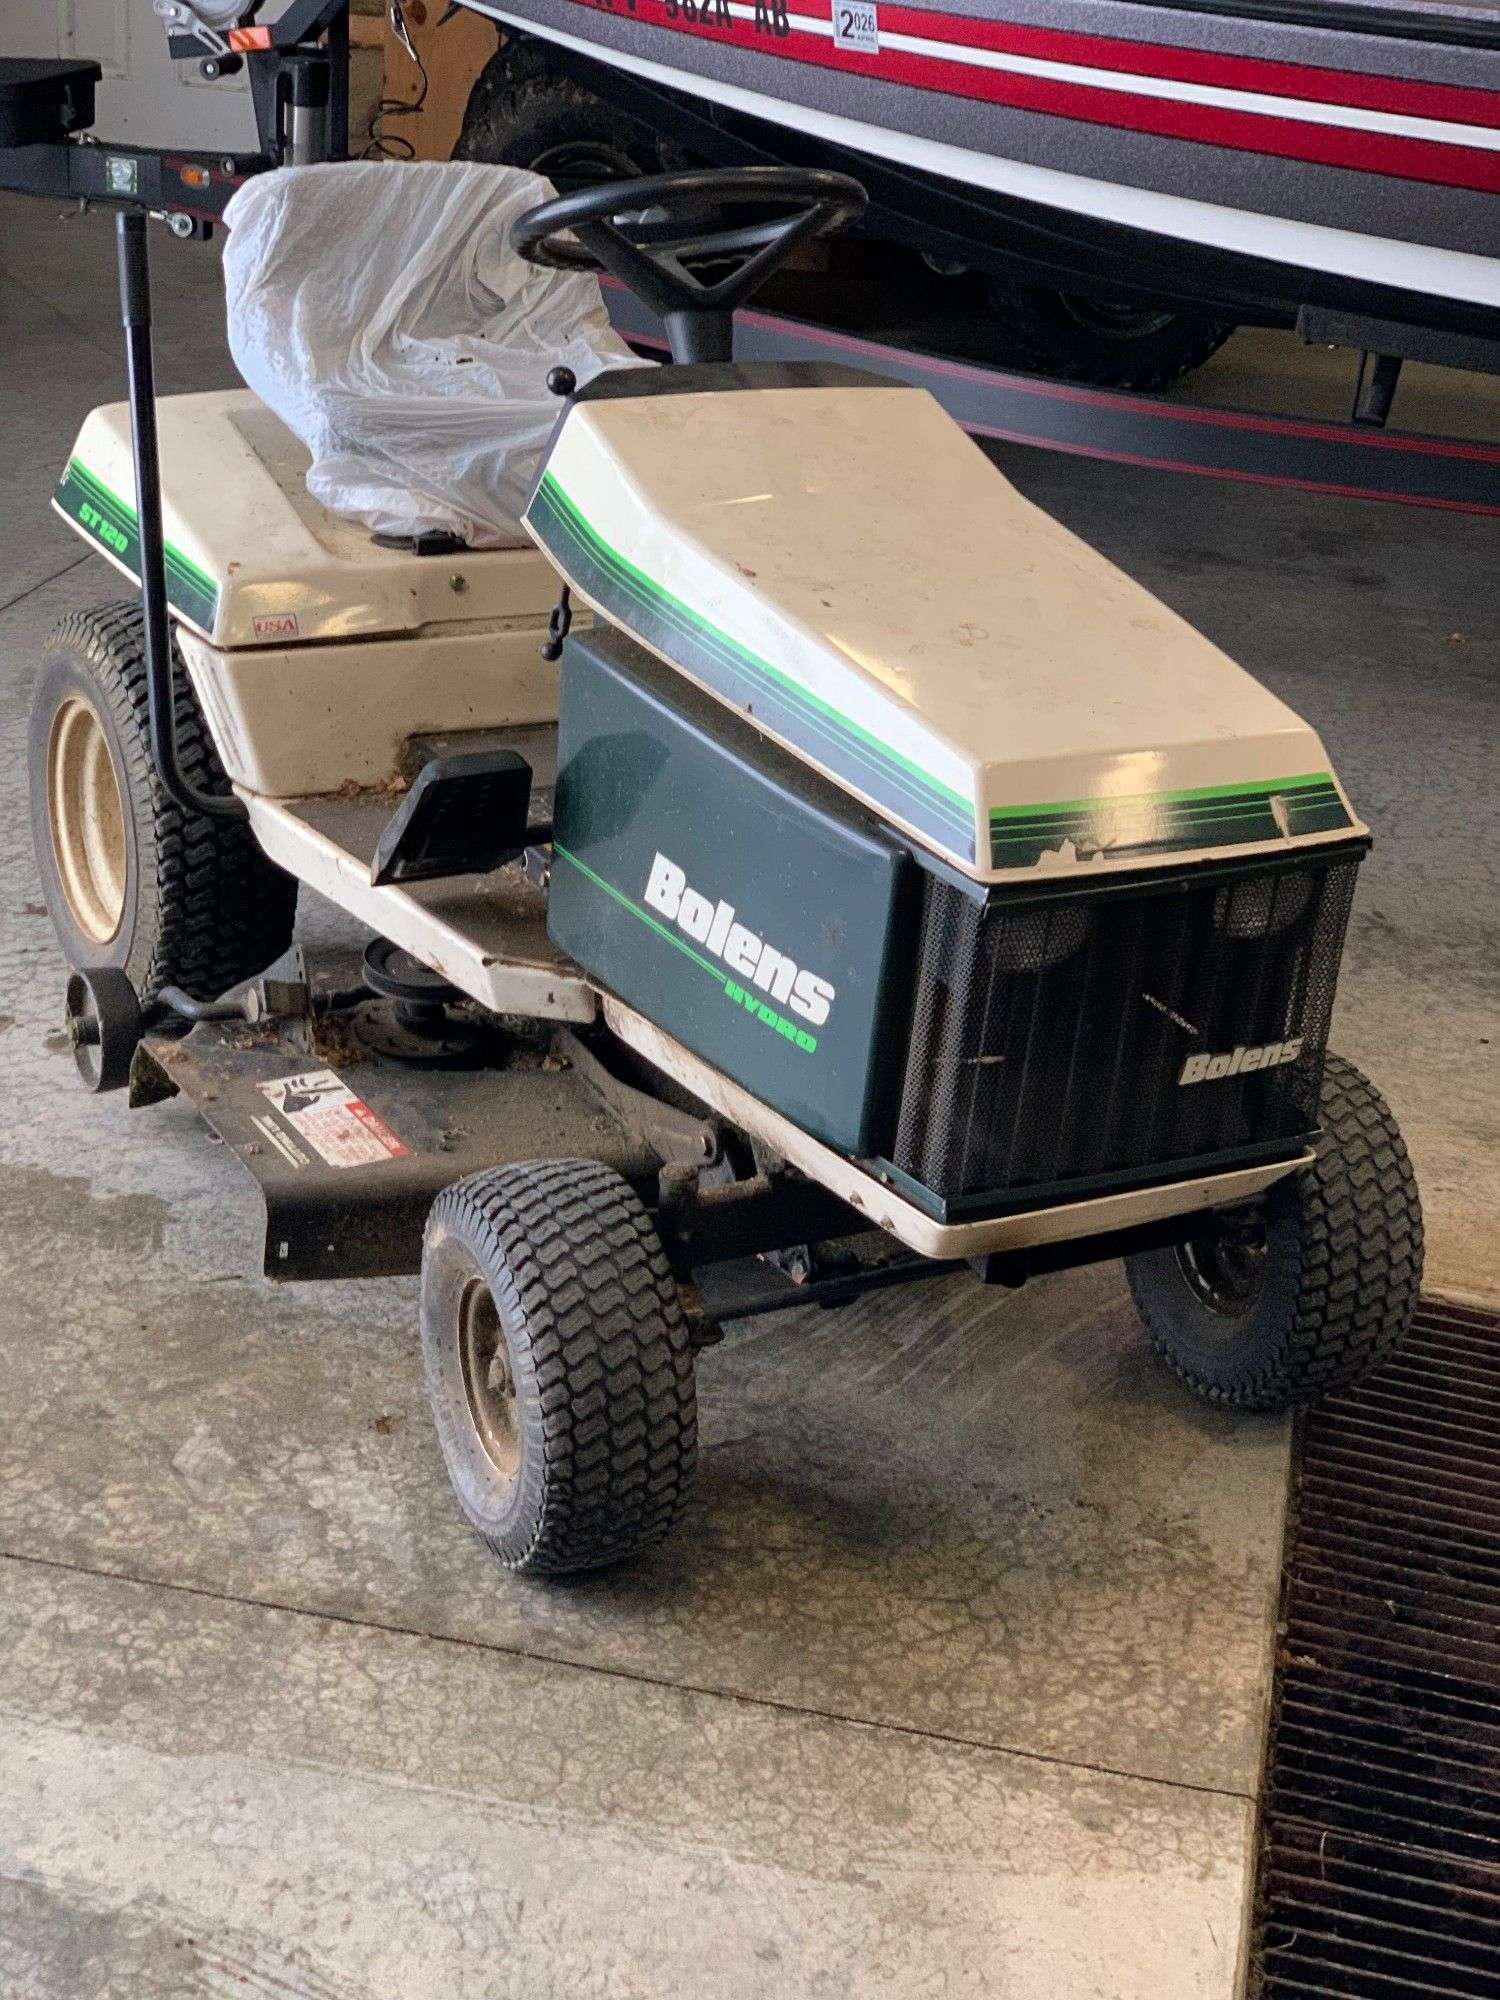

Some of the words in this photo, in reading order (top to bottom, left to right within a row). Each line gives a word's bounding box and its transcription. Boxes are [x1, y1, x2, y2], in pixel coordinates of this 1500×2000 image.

[840, 9, 875, 38] 2026
[255, 619, 295, 632] USA
[644, 851, 836, 1026] Bolens
[724, 978, 817, 1054] HYDRO
[1178, 1037, 1304, 1087] Bolens
